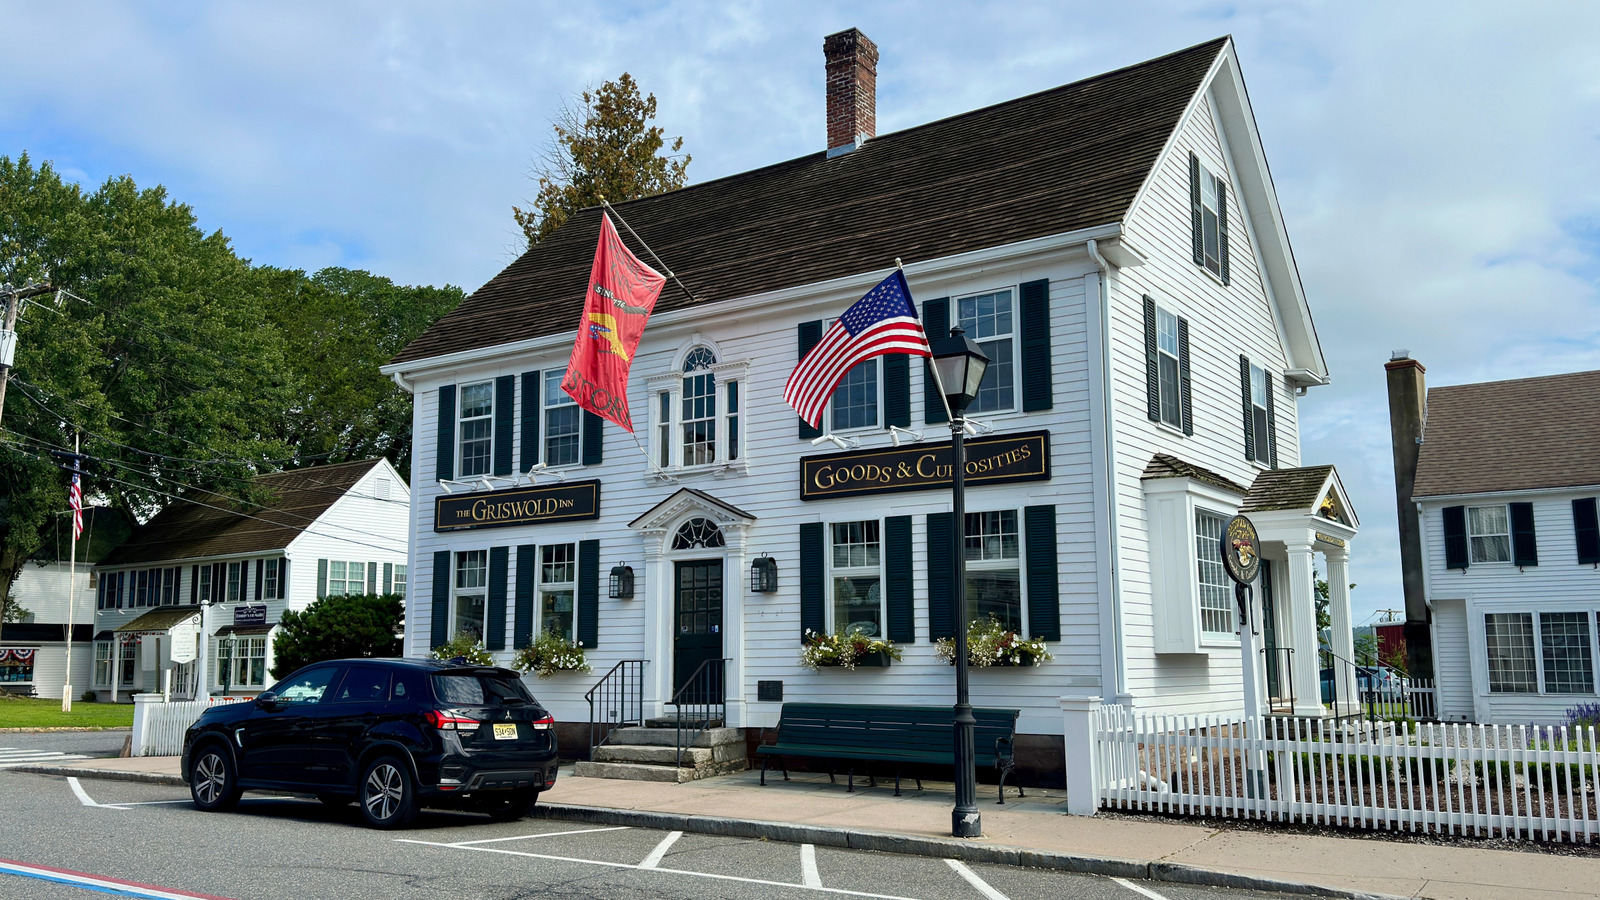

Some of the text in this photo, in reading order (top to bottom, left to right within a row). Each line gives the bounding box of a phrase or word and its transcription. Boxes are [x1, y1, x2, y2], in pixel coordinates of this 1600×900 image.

[814, 444, 1031, 489] GOODS & CUOSITIES
[456, 498, 574, 521] THE GRISWOLD INN
